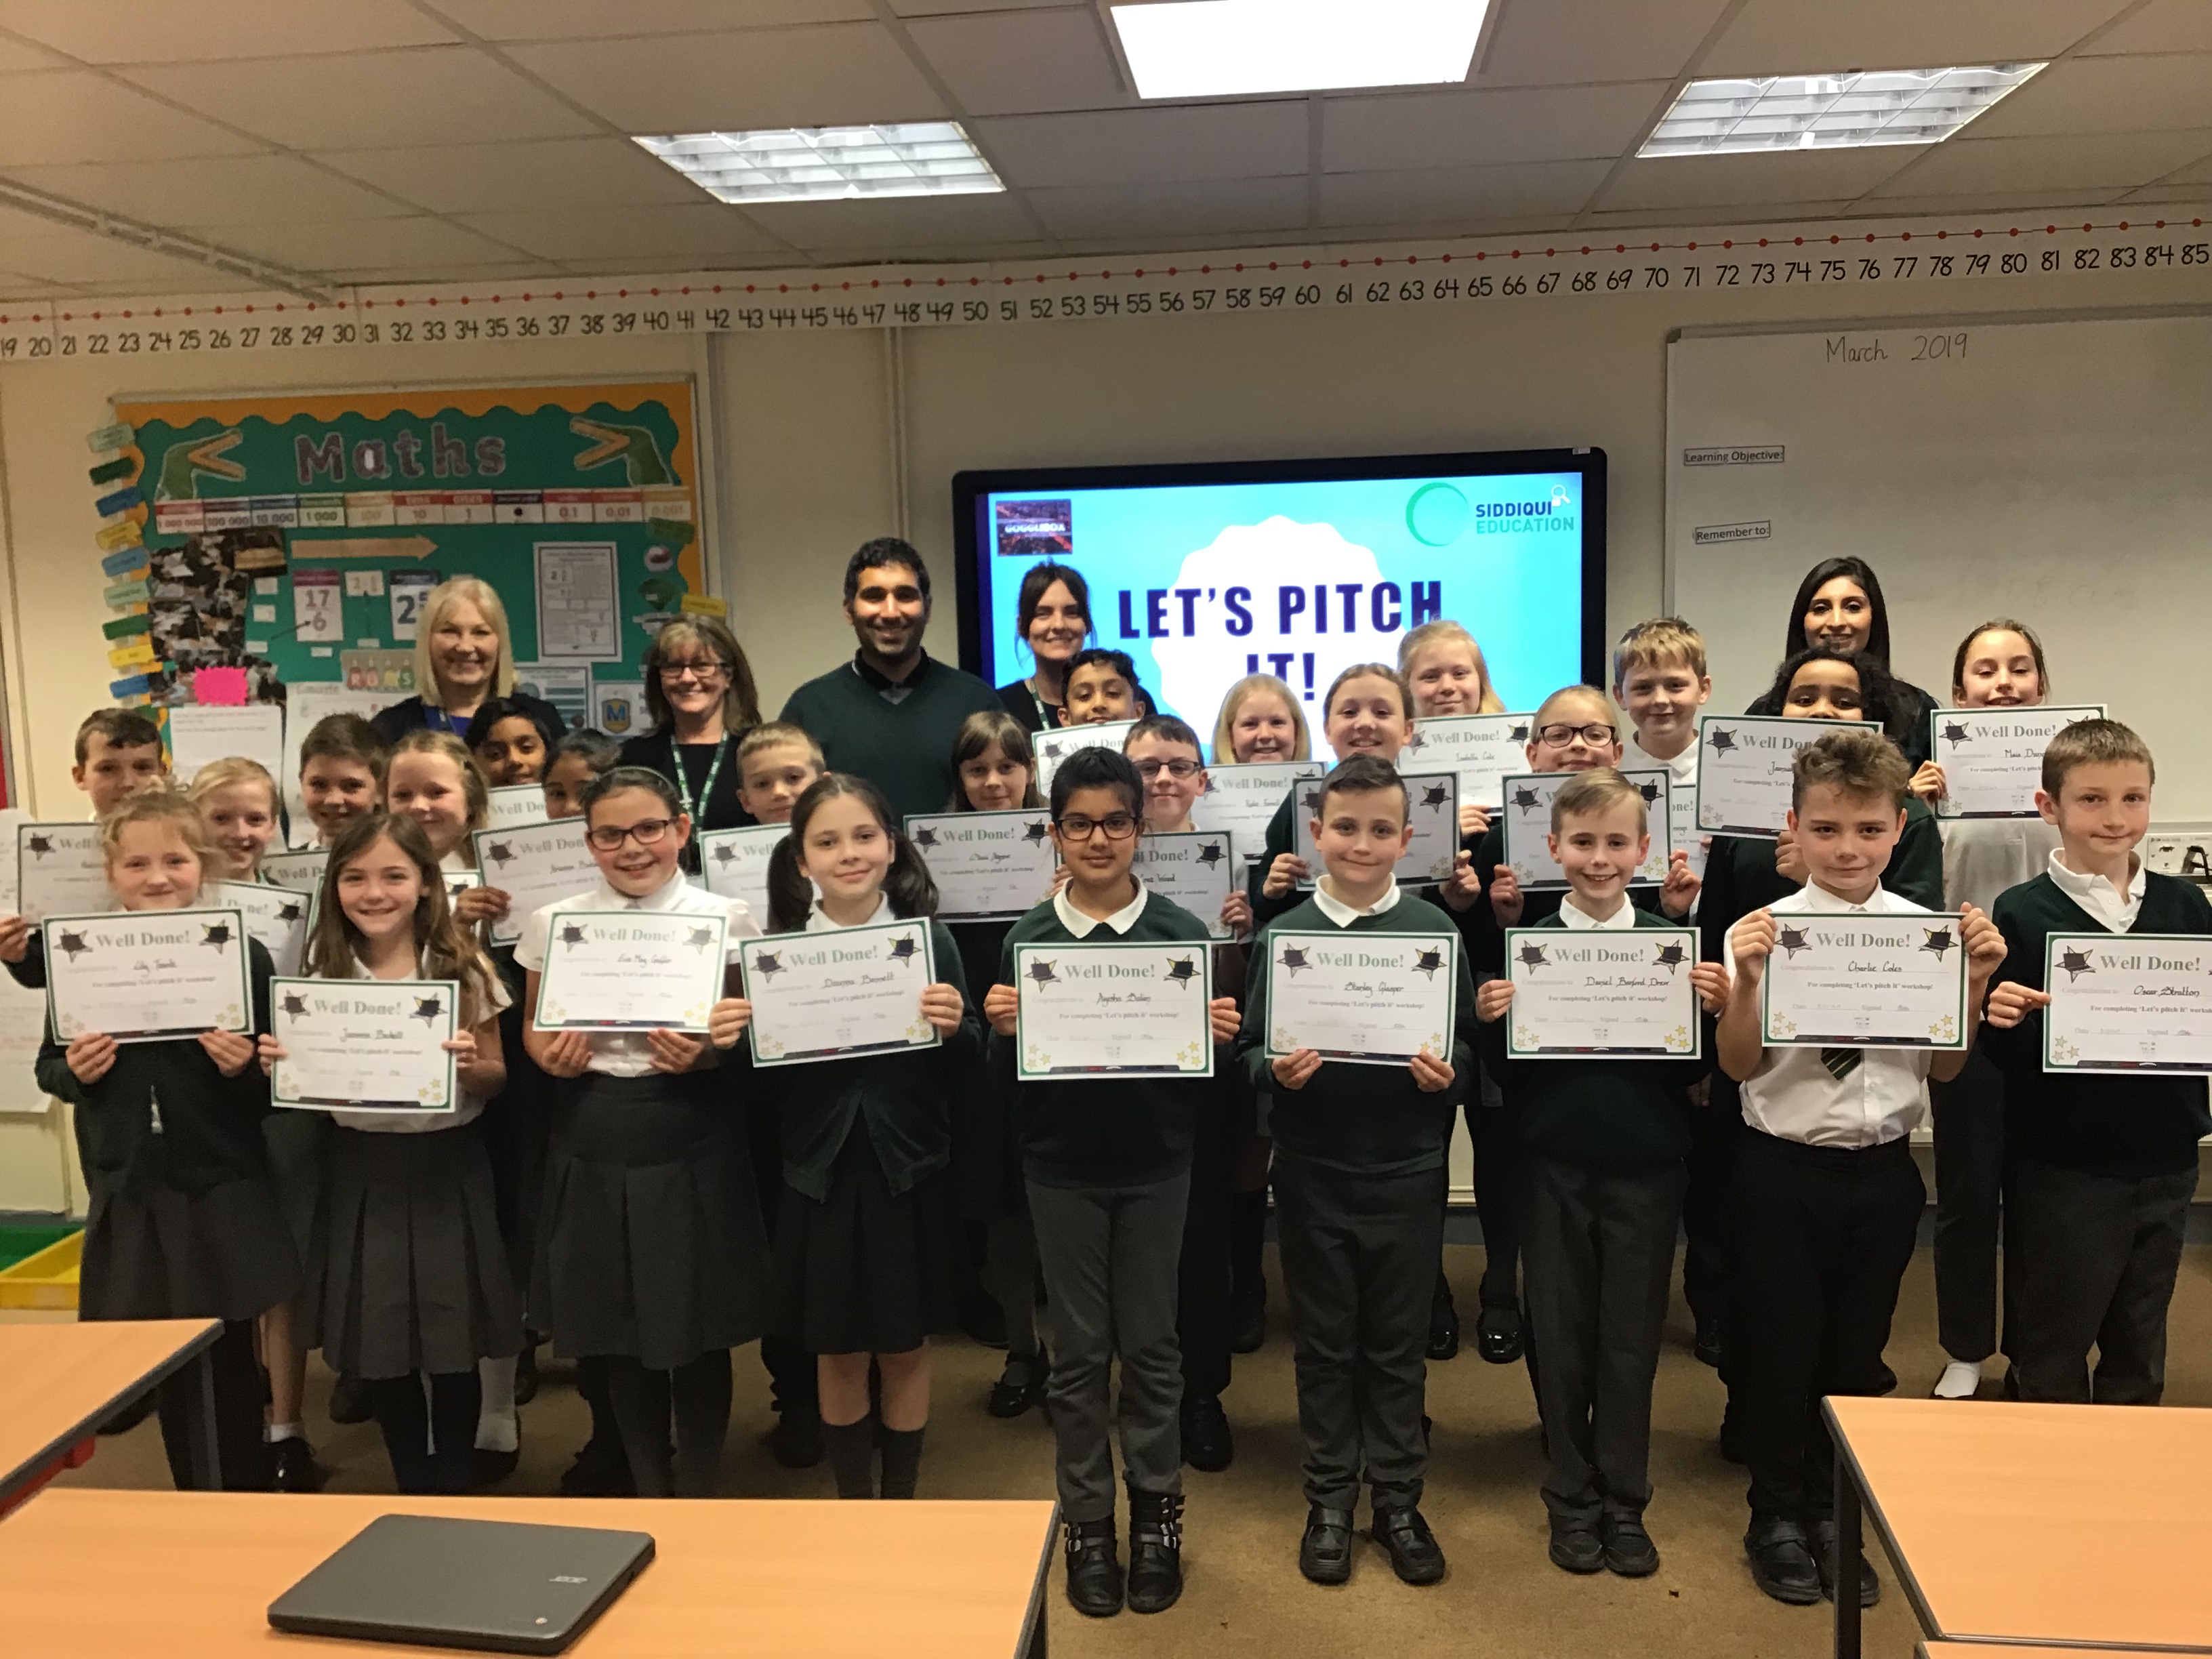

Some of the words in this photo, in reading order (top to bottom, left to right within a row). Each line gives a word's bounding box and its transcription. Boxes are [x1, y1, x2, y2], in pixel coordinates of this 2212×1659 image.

[28, 335, 52, 356] 20
[60, 334, 77, 356] 21
[87, 334, 110, 354] 22
[118, 332, 140, 353] 23
[148, 331, 172, 352] 24
[178, 329, 201, 350] 25
[209, 329, 232, 349] 26
[240, 327, 261, 348] 27
[270, 326, 293, 346] 28
[302, 325, 325, 346] 29
[333, 323, 356, 344] 30
[364, 323, 380, 344] 31
[390, 321, 413, 342] 32
[422, 321, 447, 342] 33
[454, 319, 479, 340] 34
[485, 317, 509, 338] 35
[516, 316, 540, 337] 36
[548, 314, 570, 335] 37
[580, 314, 605, 335] 38
[612, 312, 636, 333] 39
[642, 311, 669, 331] 40
[677, 310, 695, 329] 41
[705, 308, 730, 329] 42
[738, 308, 764, 329] 43
[769, 308, 796, 328] 44
[801, 306, 829, 327] 45
[833, 305, 859, 326] 46
[862, 304, 887, 324] 47
[893, 303, 921, 324] 48
[926, 302, 954, 322] 49
[962, 300, 989, 321] 50
[1000, 300, 1018, 321] 51
[1029, 298, 1053, 319] 52
[1061, 295, 1086, 316] 53
[1093, 295, 1120, 315] 54
[1126, 292, 1152, 314] 55
[1160, 291, 1185, 312] 56
[1192, 289, 1216, 310] 57
[1226, 288, 1252, 309] 58
[1259, 286, 1286, 307] 59
[1295, 284, 1321, 306] 60
[1336, 283, 1353, 304] 61
[1366, 281, 1390, 303] 62
[1399, 280, 1425, 302] 63
[1433, 279, 1460, 300] 64
[1467, 276, 1494, 298] 65
[1502, 275, 1527, 296] 66
[1536, 272, 1561, 294] 67
[1572, 271, 1598, 292] 68
[1606, 268, 1633, 291] 69
[1644, 267, 1669, 289] 70
[1683, 266, 1700, 287] 71
[1715, 264, 1740, 286] 72
[1750, 263, 1776, 285] 73
[1784, 261, 1812, 283] 74
[1820, 260, 1846, 282] 75
[1858, 258, 1881, 281] 76
[1893, 256, 1919, 279] 77
[1929, 255, 1955, 277] 78
[1965, 253, 1991, 276] 79
[2001, 253, 2028, 274] 80
[2041, 249, 2060, 272] 81
[2074, 248, 2100, 270] 82
[2110, 246, 2137, 268] 83
[2144, 245, 2175, 267] 84
[2181, 243, 2210, 265] 85
[1826, 338, 1888, 364] March
[1911, 333, 1968, 361] 2019
[295, 422, 507, 485] Maths
[1685, 452, 1729, 464] Learning
[1475, 500, 1552, 518] SIDDIQUI
[1476, 516, 1574, 534] EDUCATION
[1696, 526, 1753, 540] Remember
[305, 590, 330, 608] 17
[1277, 580, 1443, 635] PITCH
[312, 611, 327, 632] 6
[1247, 652, 1316, 701] IT!
[1431, 732, 1460, 743] Well
[1463, 730, 1500, 743] Done!
[1975, 725, 2009, 738] Well
[2013, 724, 2057, 737] Done!
[1742, 735, 1777, 750] Well
[1782, 737, 1813, 750] Don
[1221, 777, 1249, 790] Well
[1253, 777, 1288, 789] Done!
[942, 829, 973, 842] Well
[977, 826, 1016, 841] Done!
[519, 840, 552, 854] Well
[555, 838, 585, 851] Don
[1149, 848, 1189, 863] Done!
[96, 933, 136, 948] Well
[140, 930, 190, 946] Done!
[593, 928, 627, 941] Well
[631, 928, 676, 943] Done!
[1816, 933, 1856, 947] Well
[1861, 933, 1911, 949] Done!
[789, 951, 827, 967] Well
[832, 944, 879, 964] Done!
[1316, 952, 1353, 968] Well
[1358, 953, 1404, 968] Done!
[1553, 948, 1591, 962] Well
[1597, 948, 1645, 963] Done!
[2100, 955, 2142, 970] Well
[2148, 956, 2201, 972] Done!
[1064, 964, 1103, 979] Well
[1107, 964, 1155, 979] Done!
[1847, 960, 1877, 973] Charlie
[2133, 985, 2158, 996] Oscar
[2158, 985, 2200, 998] Stratton
[314, 999, 349, 1015] Well
[354, 1000, 403, 1016] Done!
